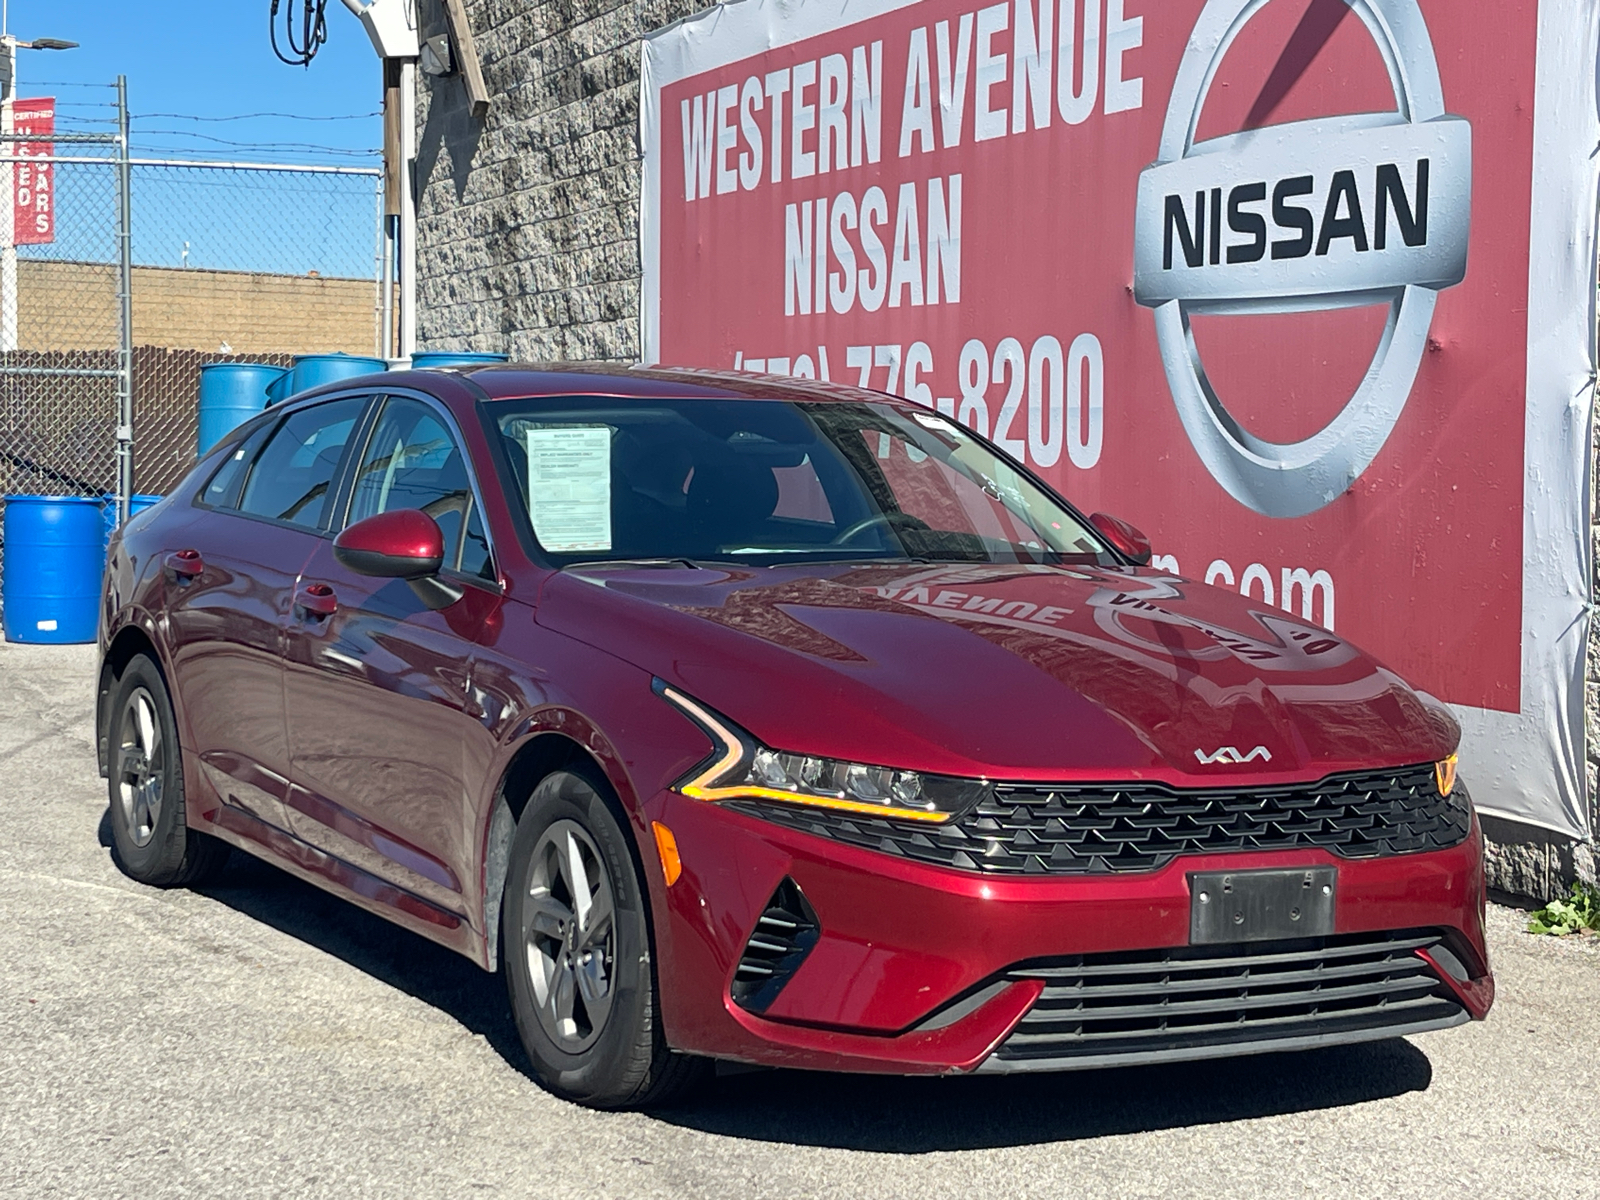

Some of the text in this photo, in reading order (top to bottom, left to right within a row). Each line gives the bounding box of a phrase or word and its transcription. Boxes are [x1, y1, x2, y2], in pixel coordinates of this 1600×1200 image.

[14, 109, 54, 121] CERTIFIED
[681, 0, 1143, 202] WESTERN AVENUE
[785, 173, 962, 317] NISSAN
[1163, 158, 1429, 270] NISSAN
[1194, 745, 1272, 764] KIA
